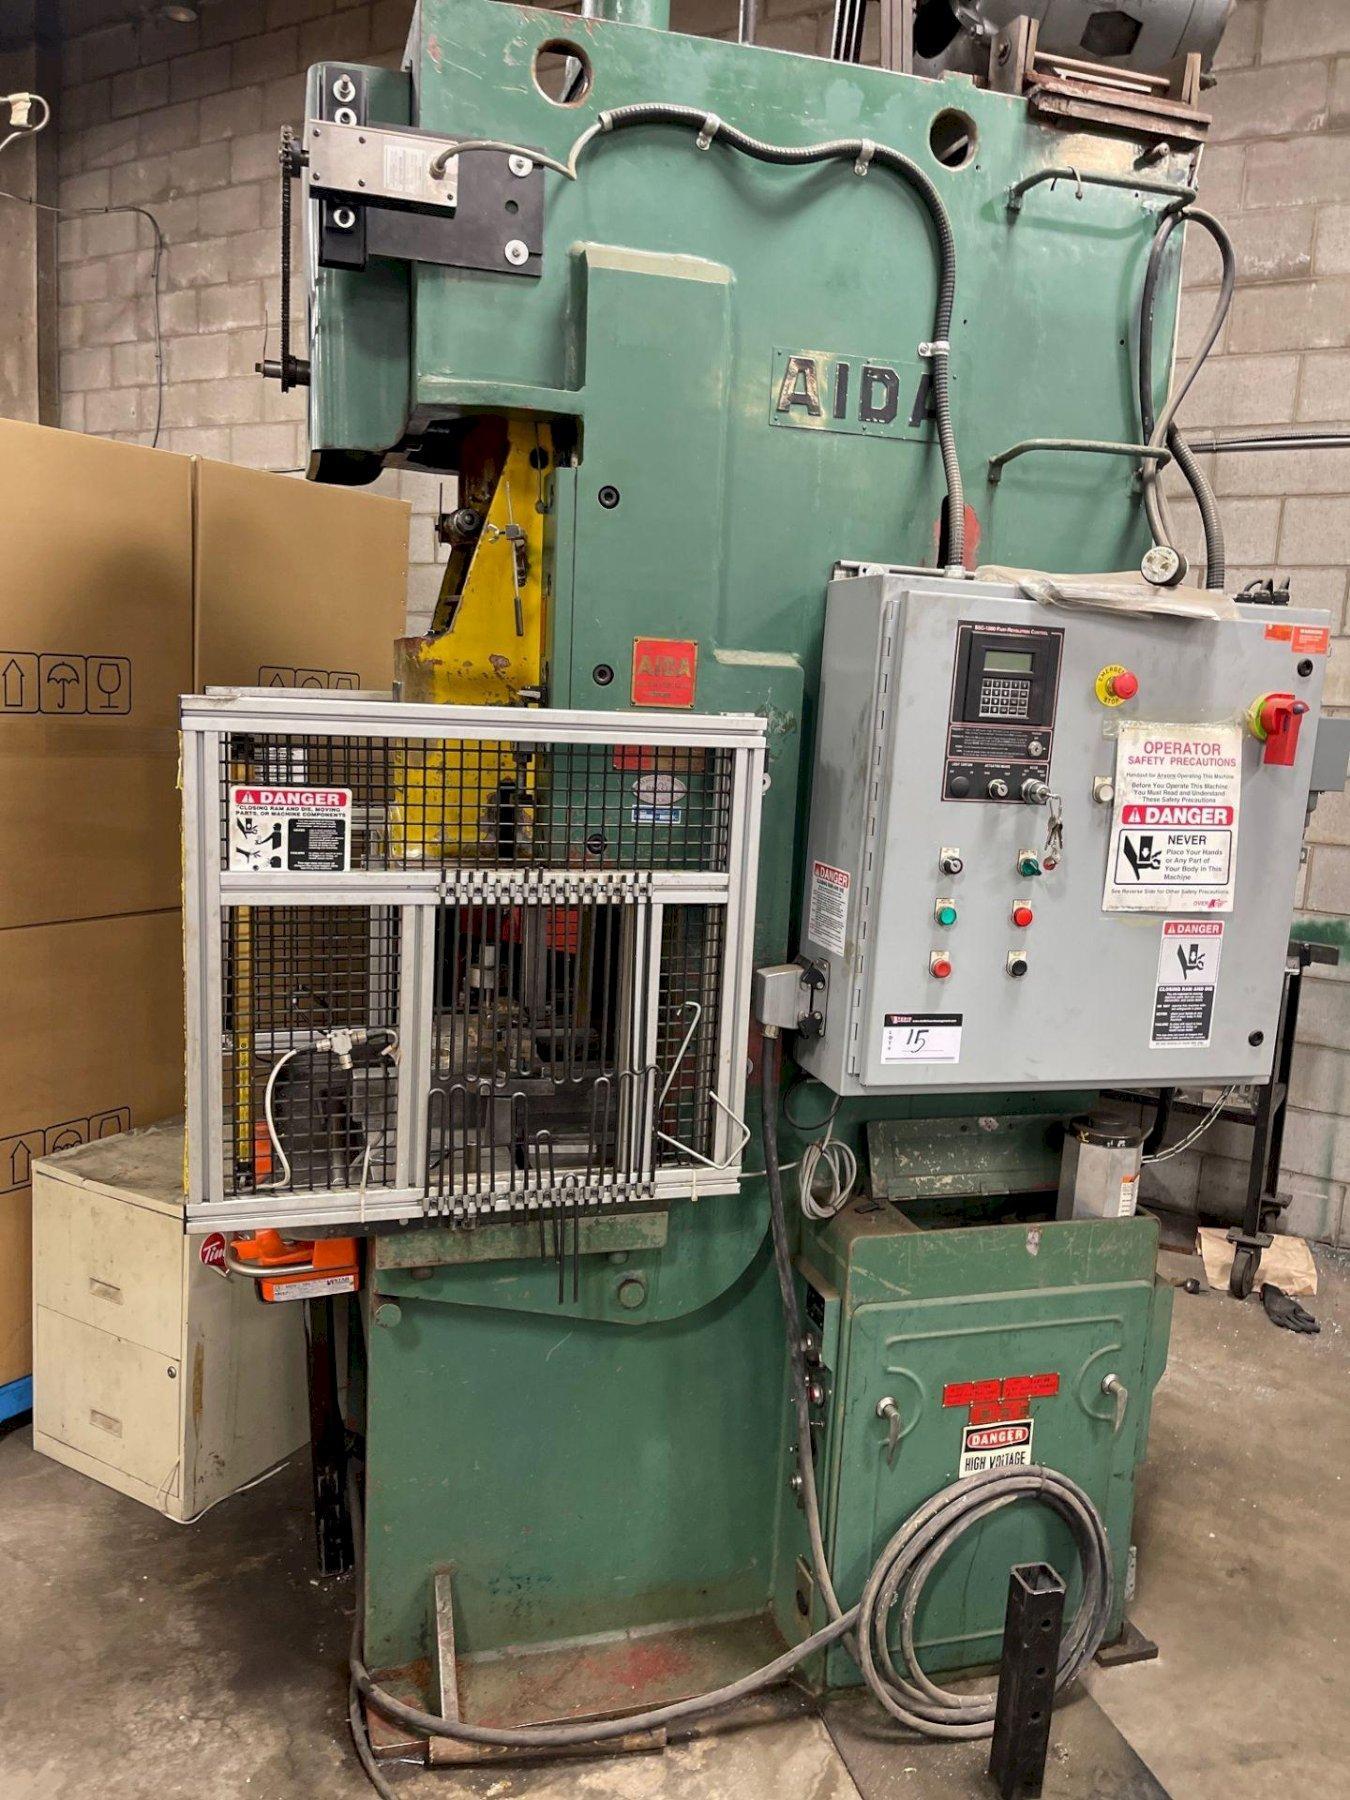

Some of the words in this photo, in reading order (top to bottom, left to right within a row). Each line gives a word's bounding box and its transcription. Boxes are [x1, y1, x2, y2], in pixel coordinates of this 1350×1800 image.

[776, 355, 937, 427] AIDA
[1143, 741, 1221, 756] OPERATOR
[1128, 756, 1165, 765] SAFETY
[1170, 757, 1236, 767] PRECAUTIONS
[260, 792, 340, 805] DANGER
[1145, 806, 1228, 824] DANGER
[1167, 835, 1207, 845] NEVER
[820, 867, 847, 887] DANGER
[1177, 925, 1219, 934] DANGER
[906, 1029, 929, 1053] 15
[972, 1430, 1023, 1446] DANGER
[965, 1456, 986, 1471] HIGH
[990, 1451, 1026, 1468] VOLTAGE
